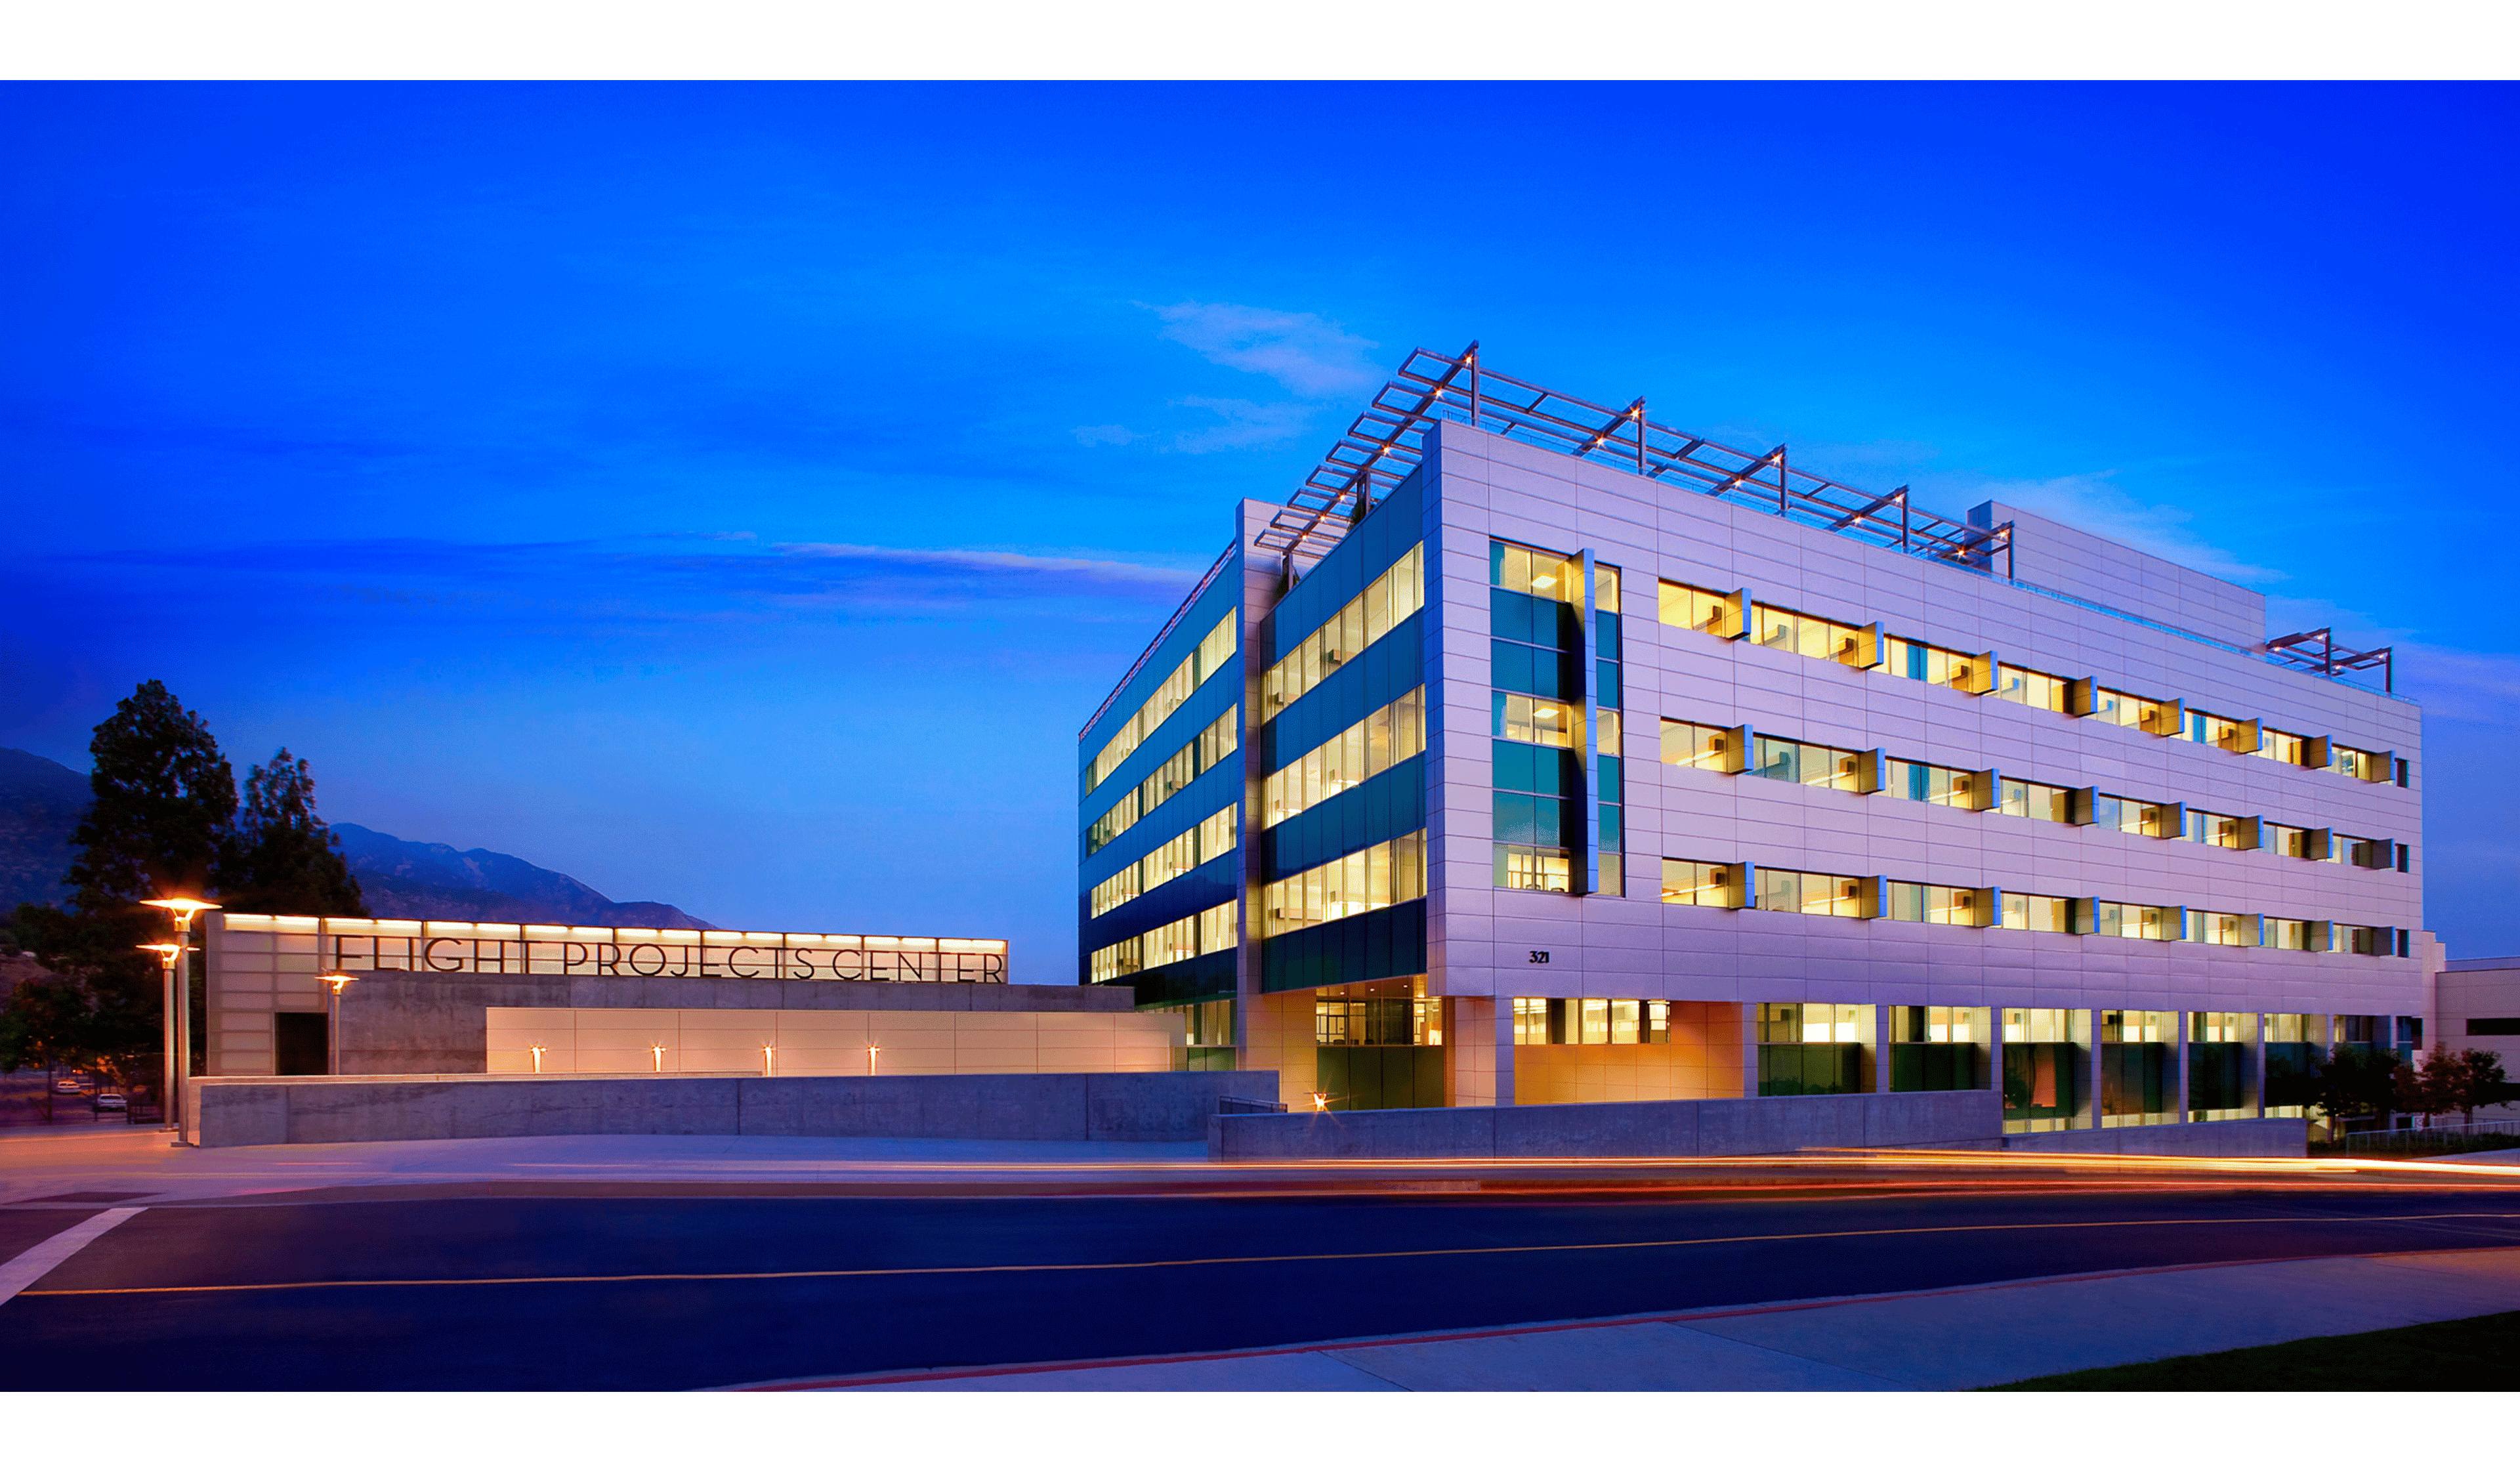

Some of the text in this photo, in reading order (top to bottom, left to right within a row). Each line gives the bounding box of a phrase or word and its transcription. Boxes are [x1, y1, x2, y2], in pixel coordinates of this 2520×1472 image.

[335, 935, 1003, 984] FLIGHT PROJECTS CENTER
[1529, 950, 1549, 964] 321
